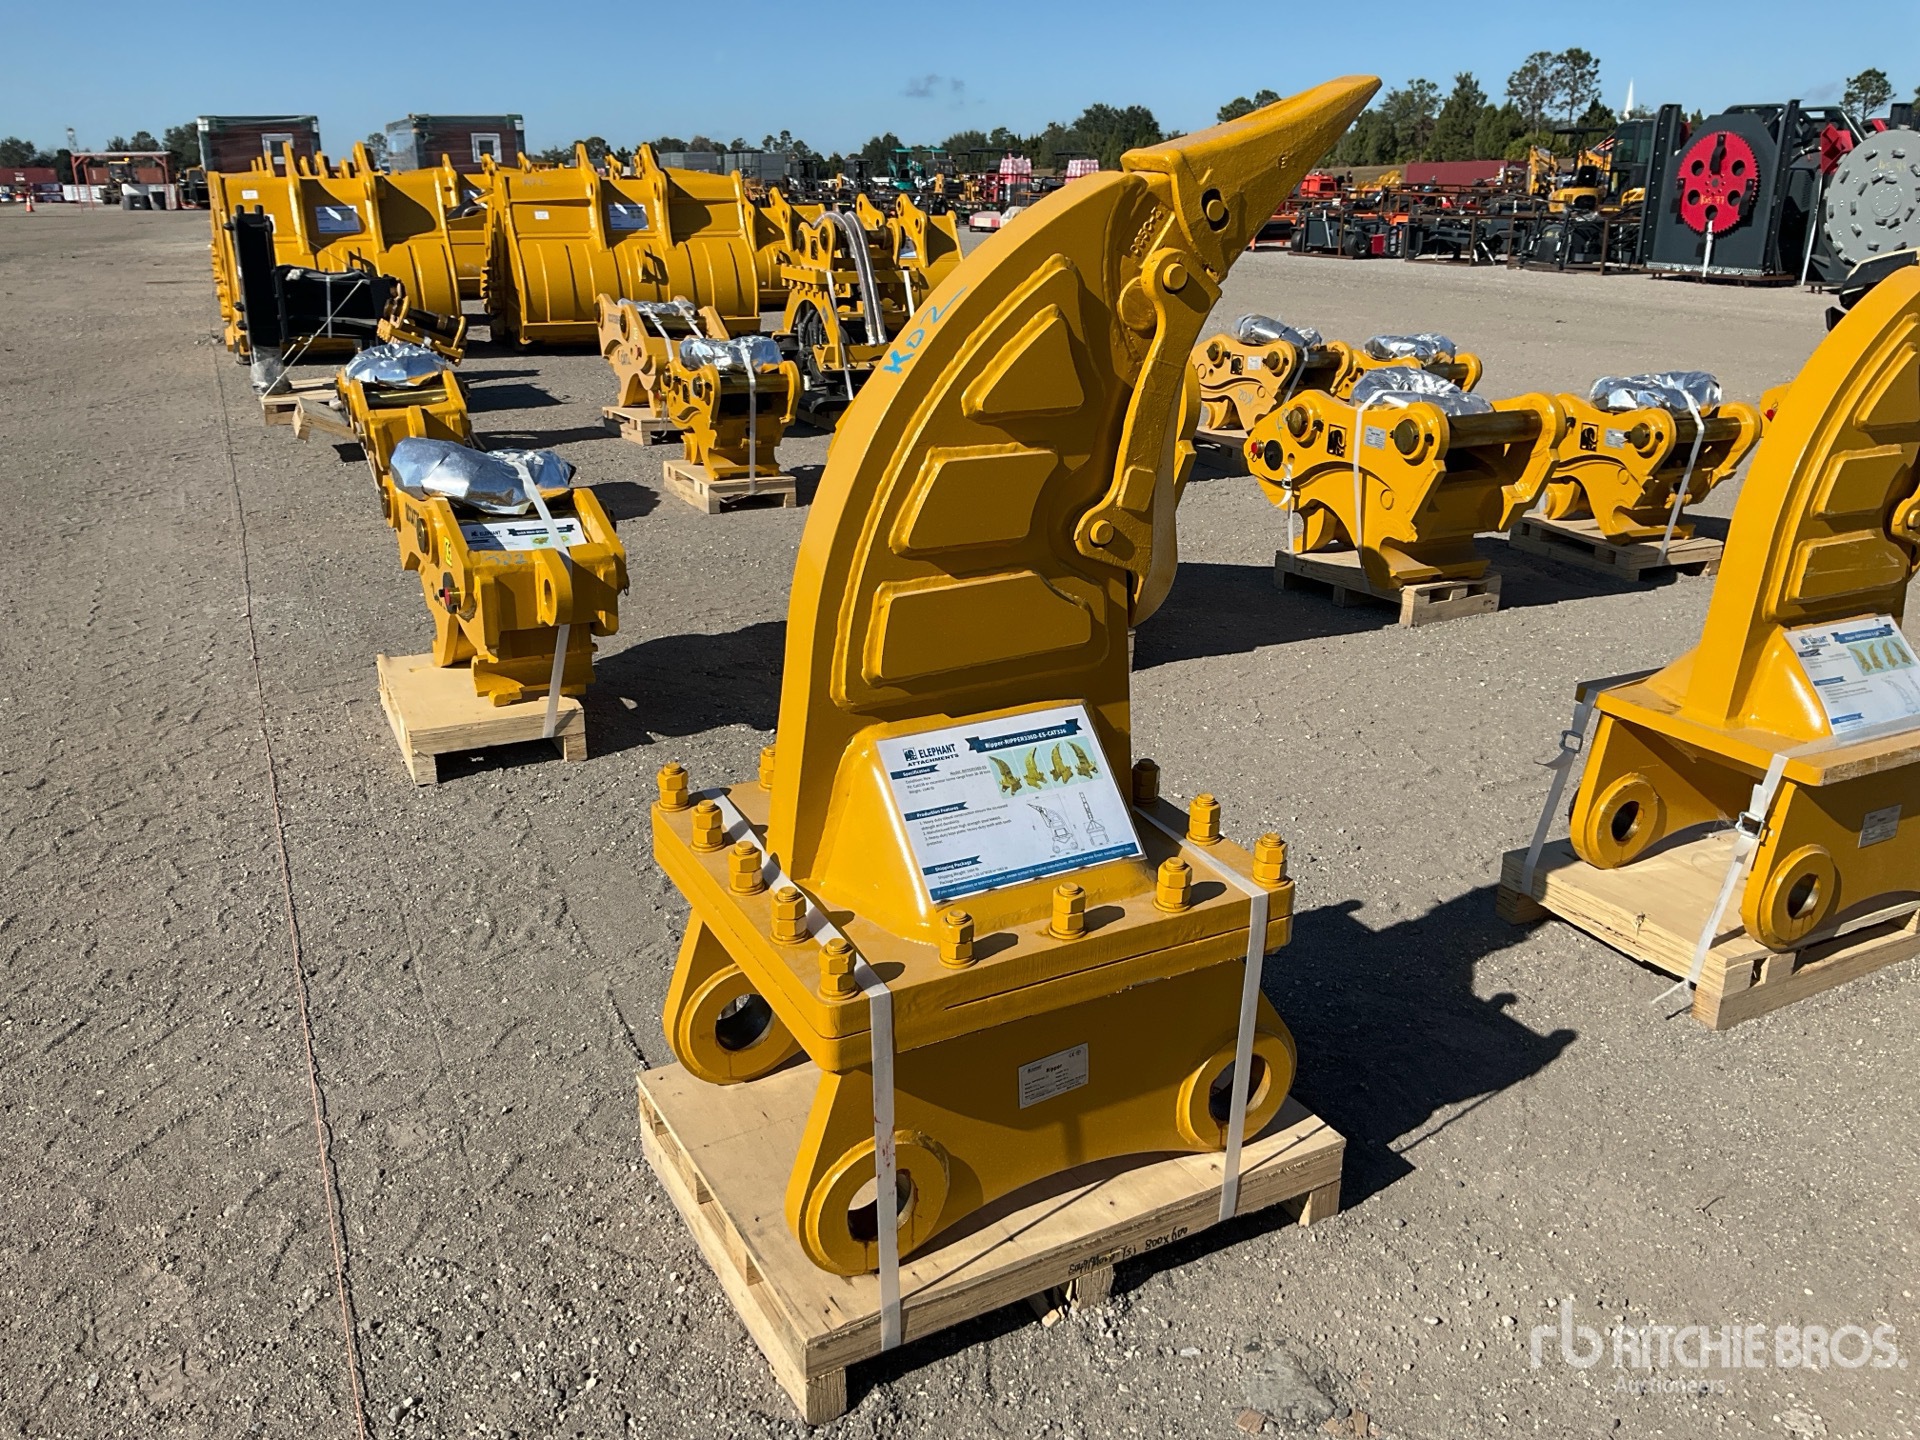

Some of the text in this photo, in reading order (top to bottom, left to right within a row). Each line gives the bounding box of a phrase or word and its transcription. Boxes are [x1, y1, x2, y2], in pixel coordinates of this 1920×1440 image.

[918, 744, 956, 757] ELEPHANT
[907, 754, 959, 766] ATTACHMENTS
[903, 768, 930, 776] Specification
[916, 809, 940, 817] Production
